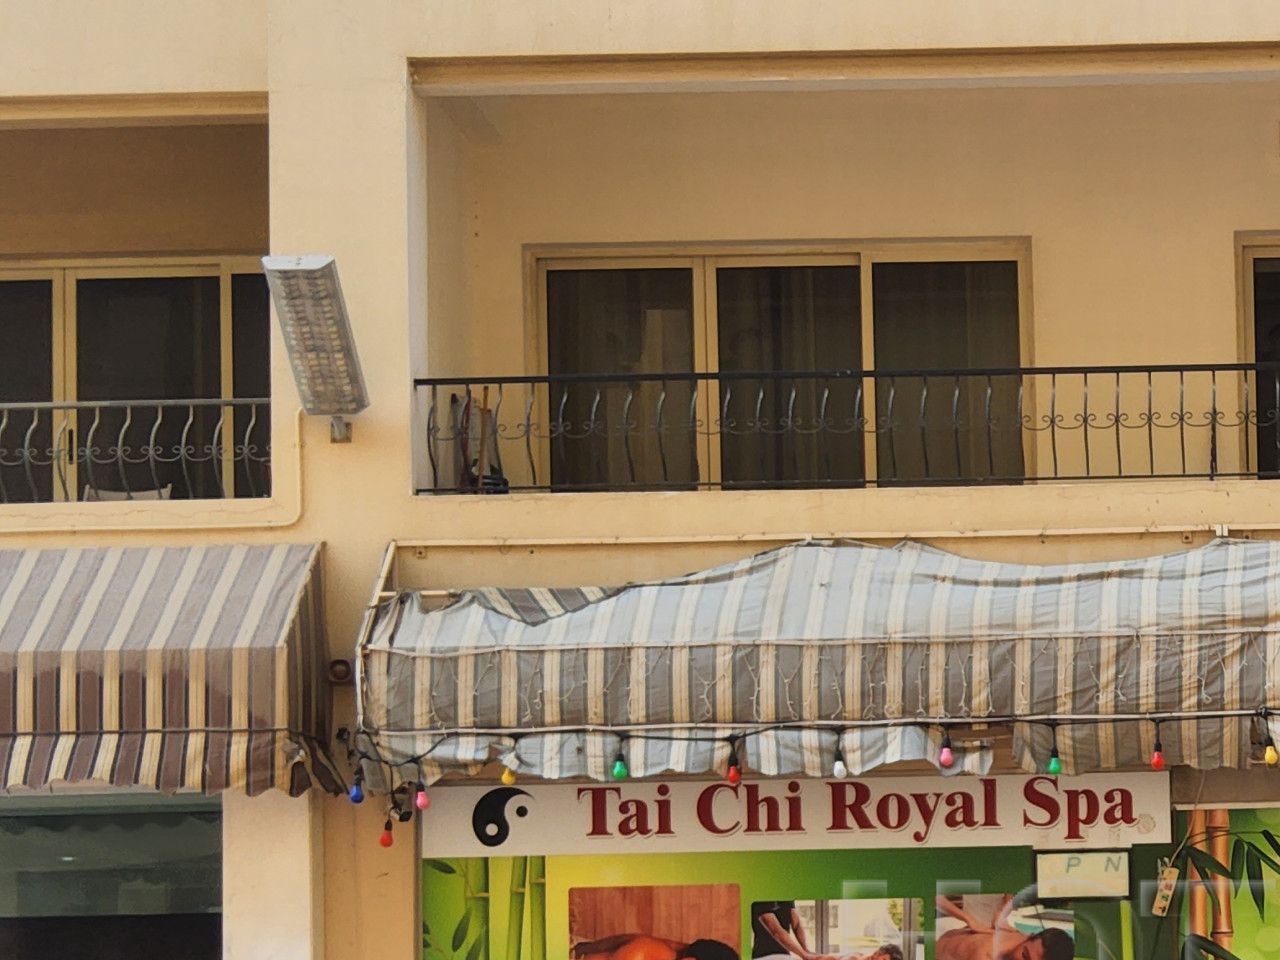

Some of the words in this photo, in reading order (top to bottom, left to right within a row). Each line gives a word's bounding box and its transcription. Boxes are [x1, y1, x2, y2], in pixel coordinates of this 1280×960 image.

[577, 783, 674, 837] Tai
[696, 780, 805, 835] Chi
[826, 778, 1001, 843] Royal
[1023, 776, 1138, 840] Spa
